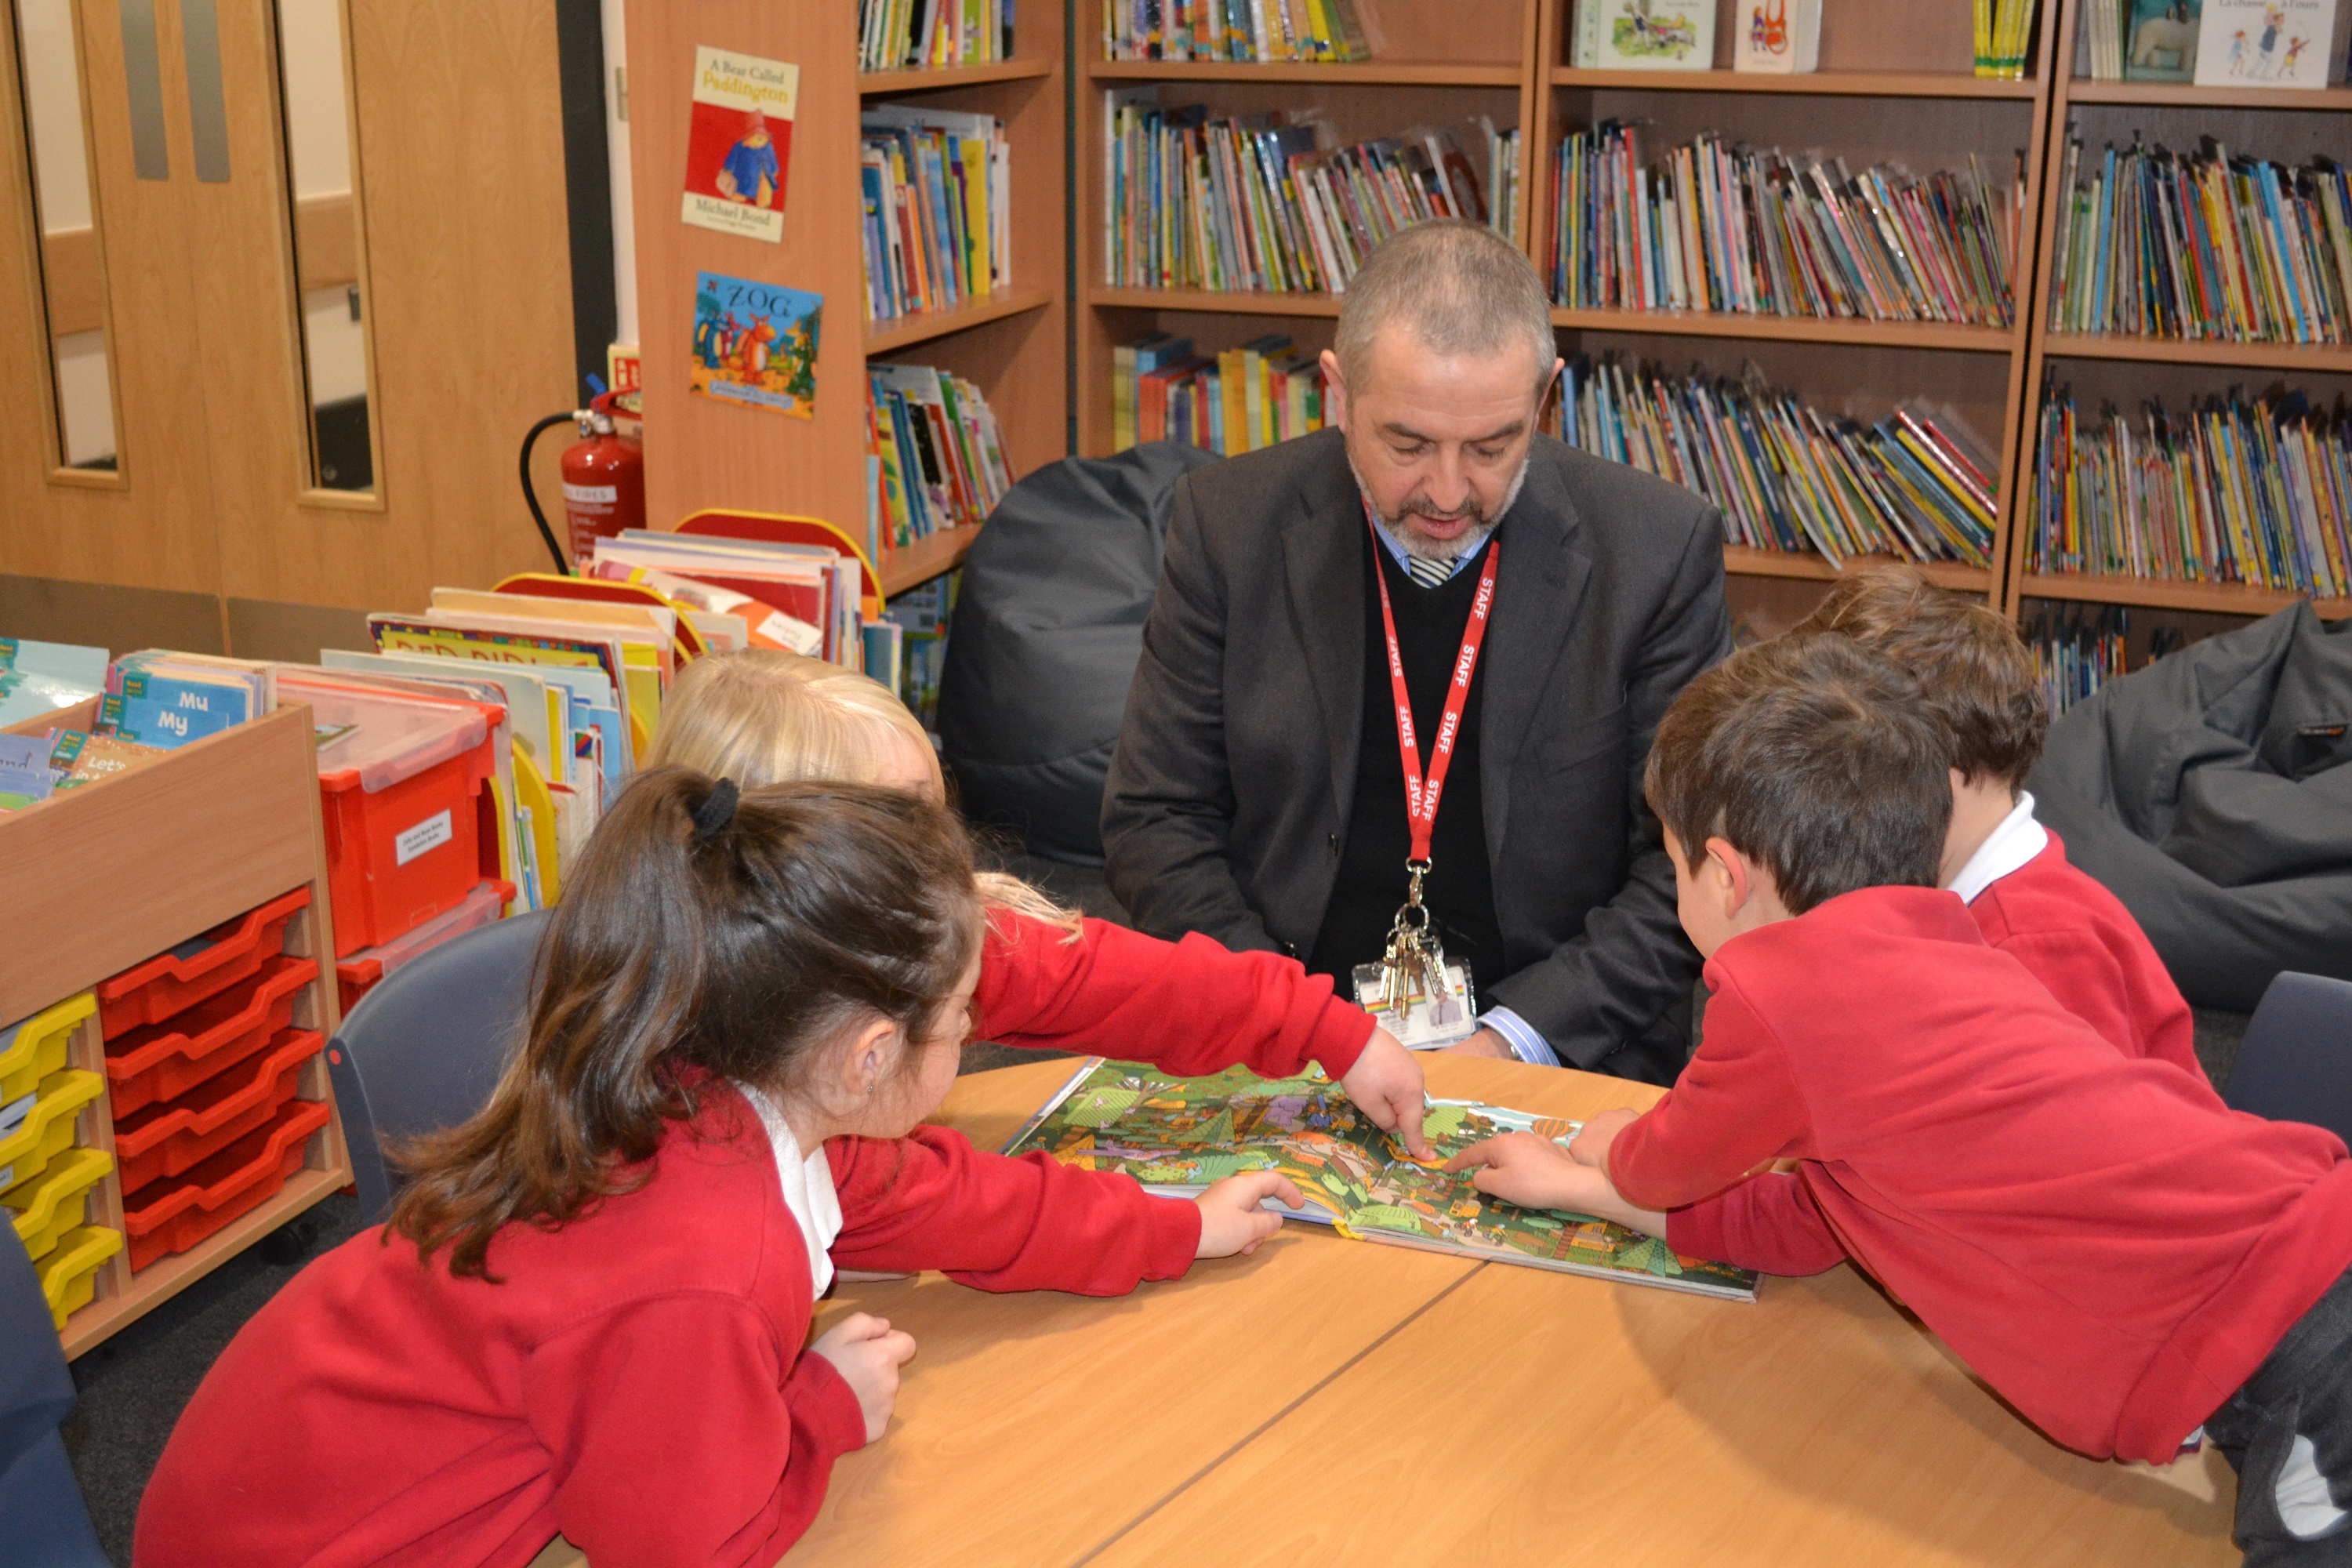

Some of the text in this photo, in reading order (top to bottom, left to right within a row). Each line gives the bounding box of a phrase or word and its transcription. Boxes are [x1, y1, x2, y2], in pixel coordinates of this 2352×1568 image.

[702, 69, 789, 104] Paddington
[710, 59, 784, 85] A Bear Called
[695, 198, 739, 219] Michael
[741, 207, 771, 226] Bond
[727, 285, 792, 318] ZOG
[1388, 636, 1403, 677] STAFF
[1422, 576, 1493, 822] STAFF STAFF STAFF STAFF
[158, 710, 188, 737] My
[1399, 705, 1414, 748] STAFF
[1409, 774, 1422, 817] STAFF
